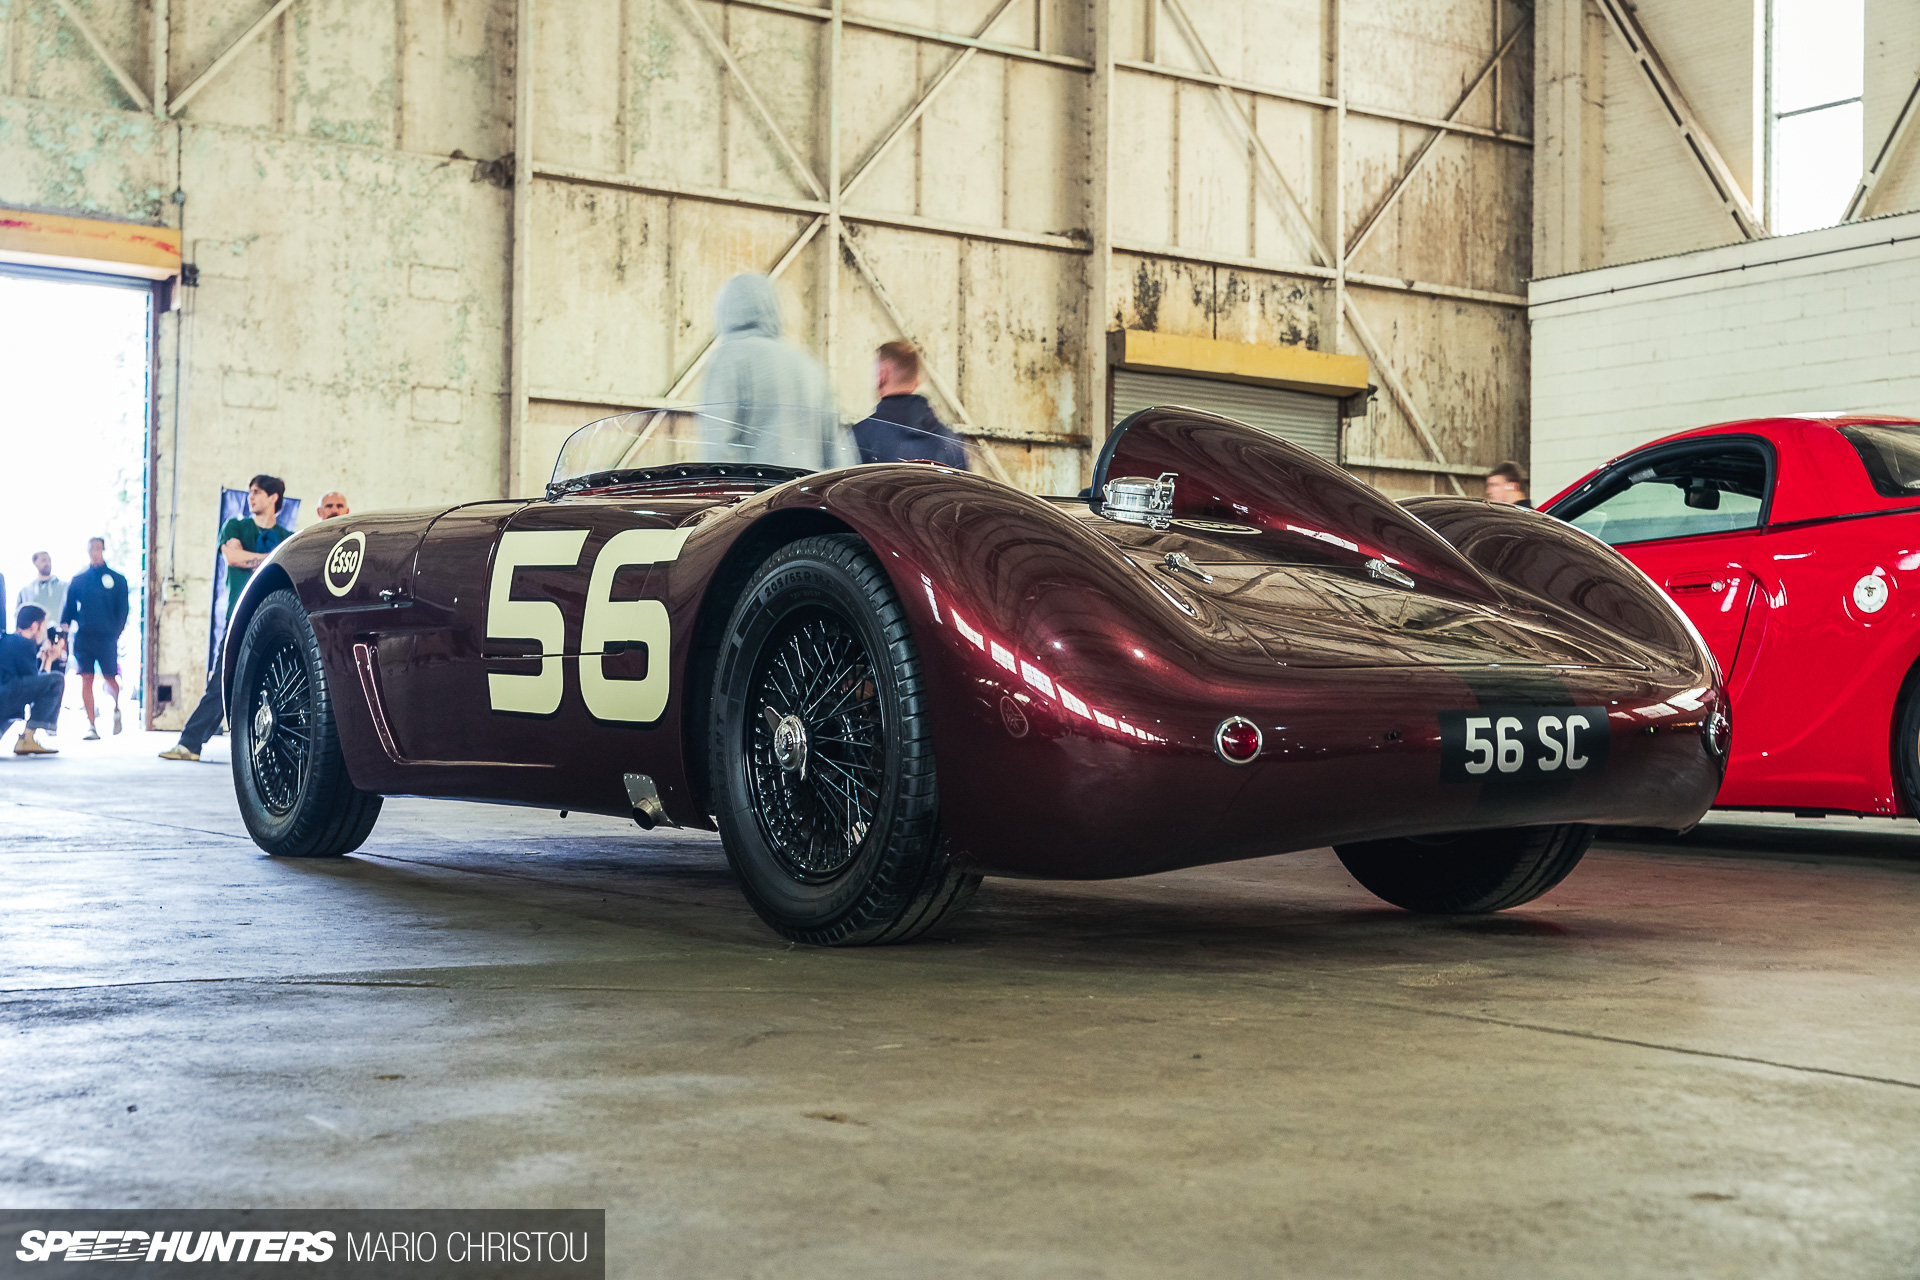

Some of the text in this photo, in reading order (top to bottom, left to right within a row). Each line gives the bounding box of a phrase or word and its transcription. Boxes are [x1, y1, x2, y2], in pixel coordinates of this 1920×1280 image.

[487, 526, 697, 722] 56
[1465, 715, 1590, 774] 56 SC
